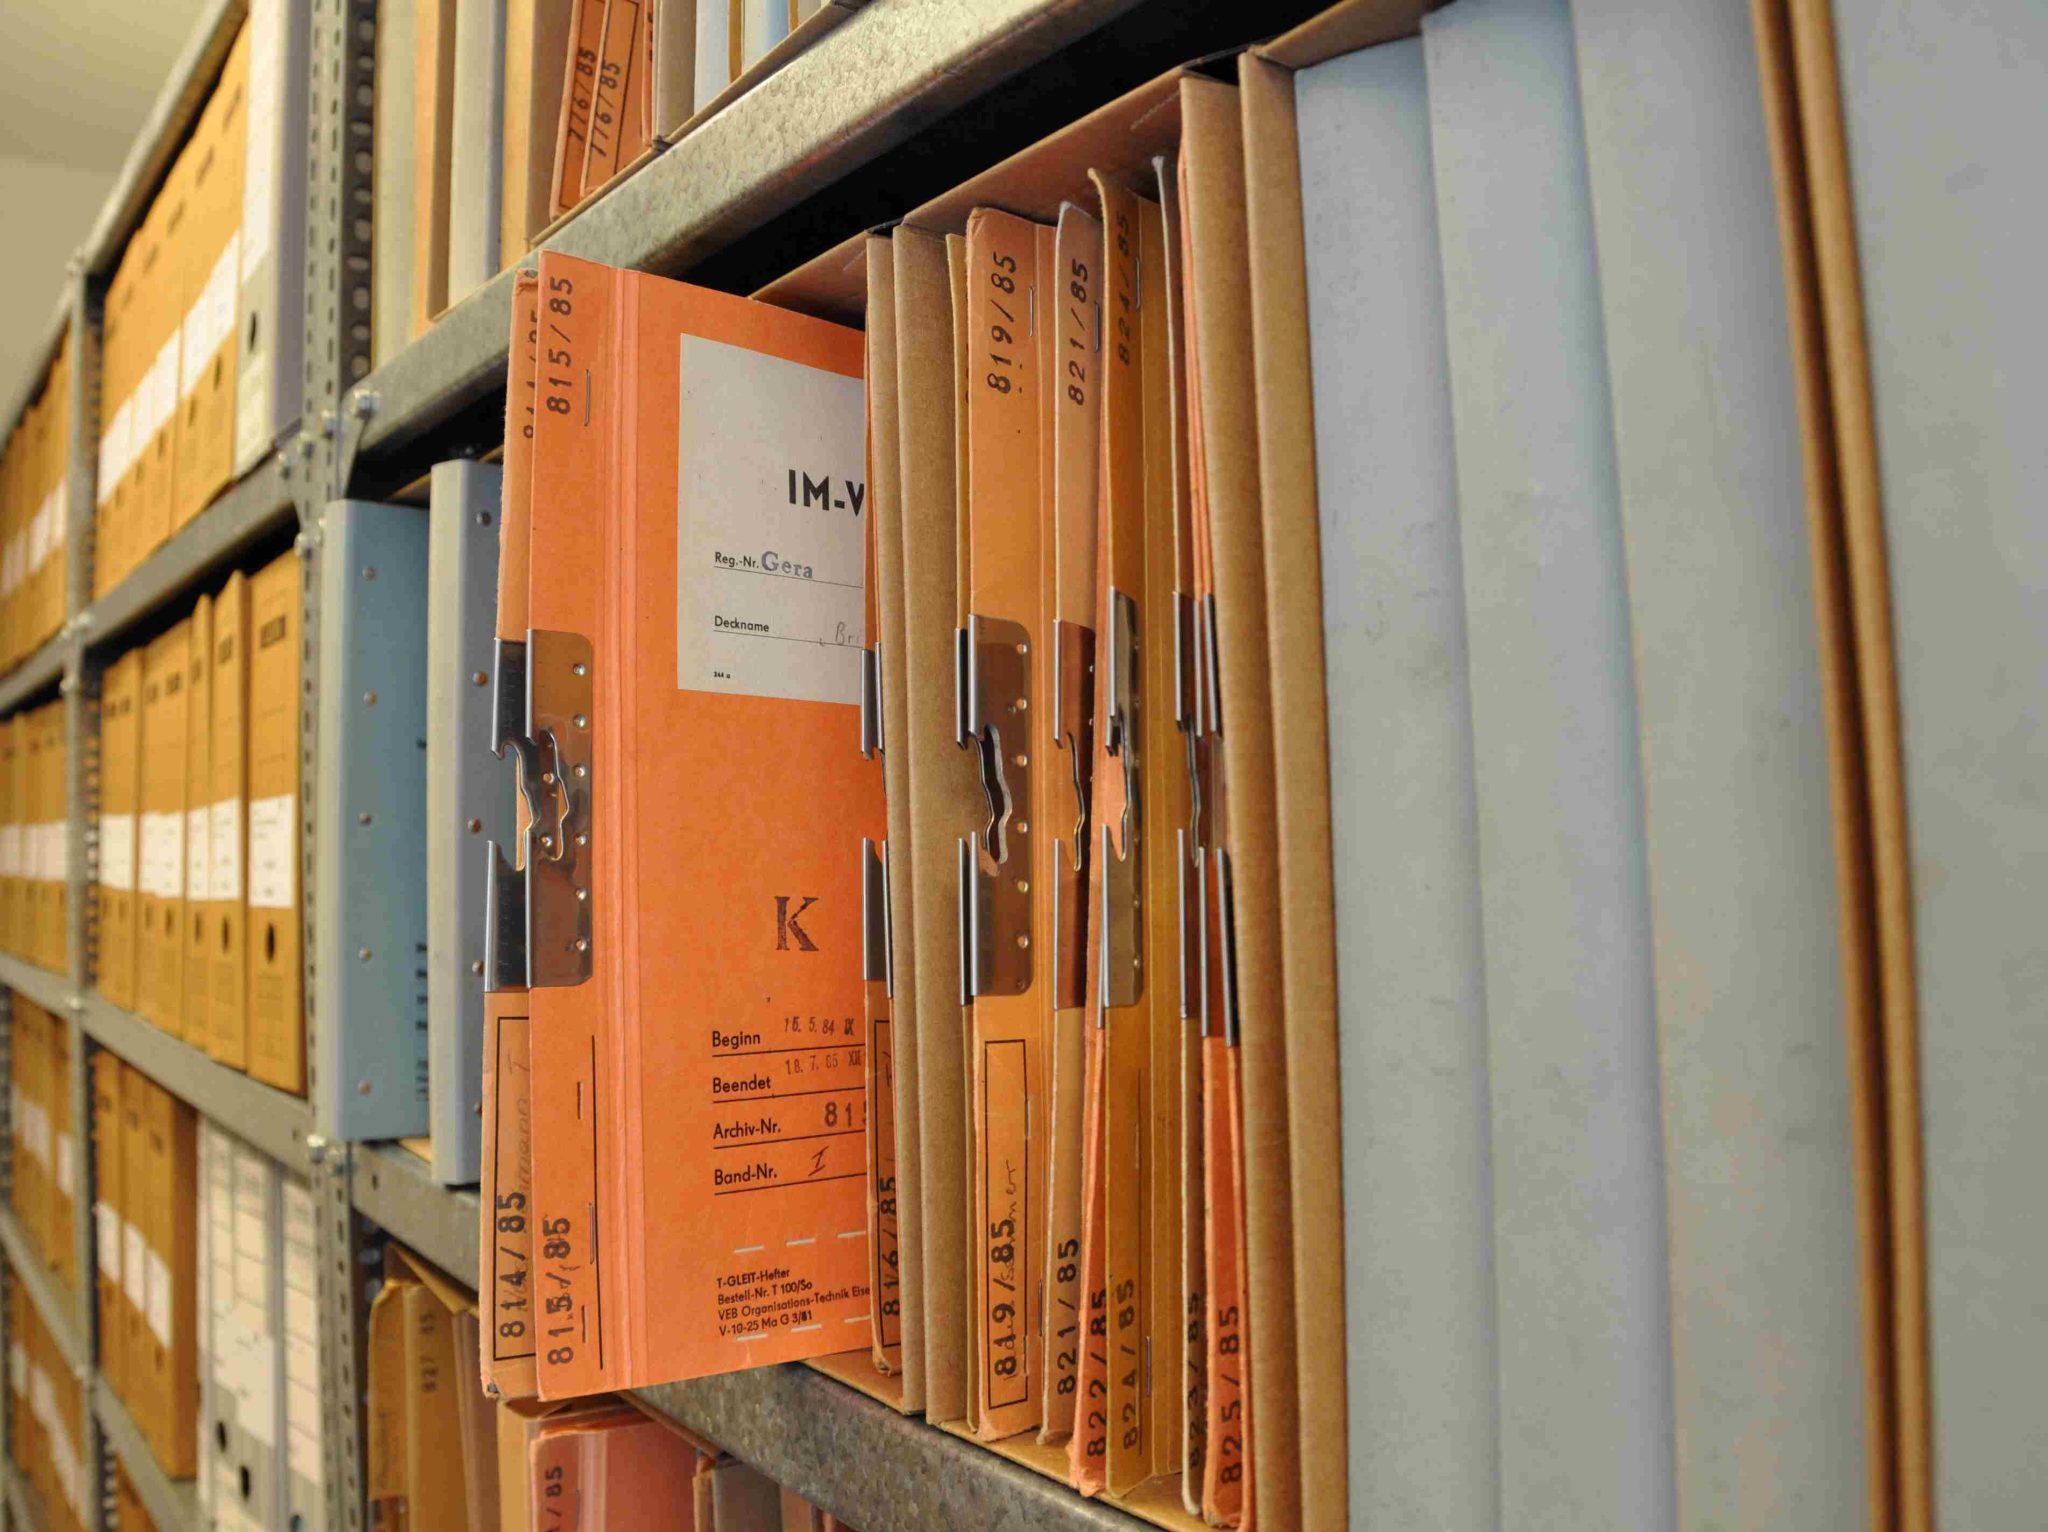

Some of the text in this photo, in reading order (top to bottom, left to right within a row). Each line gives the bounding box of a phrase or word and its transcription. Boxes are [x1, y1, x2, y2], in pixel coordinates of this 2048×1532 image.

[546, 276, 573, 415] 815/85
[986, 251, 1017, 395] 819/85
[1067, 258, 1088, 406] 821/85
[788, 469, 865, 517] IM-V
[714, 550, 814, 579] Reg.-Nr. Gera
[714, 615, 770, 633] Deckname
[774, 895, 820, 951] K
[712, 1031, 761, 1049] Beginn
[712, 1073, 771, 1094] Beendet
[713, 1118, 781, 1140] Archiv-Nr.
[714, 1163, 778, 1186] Band-Nr.
[497, 1192, 527, 1338] 814/85
[716, 1268, 790, 1289] T-GLEIT-Hefter
[542, 1217, 575, 1366] 815/85
[718, 1286, 770, 1305] Bestell-Nr.
[771, 1284, 779, 1296] T
[718, 1308, 738, 1321] VEB
[741, 1289, 850, 1317] Organisations-Technik
[990, 1219, 1017, 1376] 819/85
[761, 1316, 777, 1330] Ma
[1056, 1238, 1079, 1395] 821/85
[1116, 1278, 1138, 1450] 824/85
[1219, 1305, 1243, 1485] 825/85
